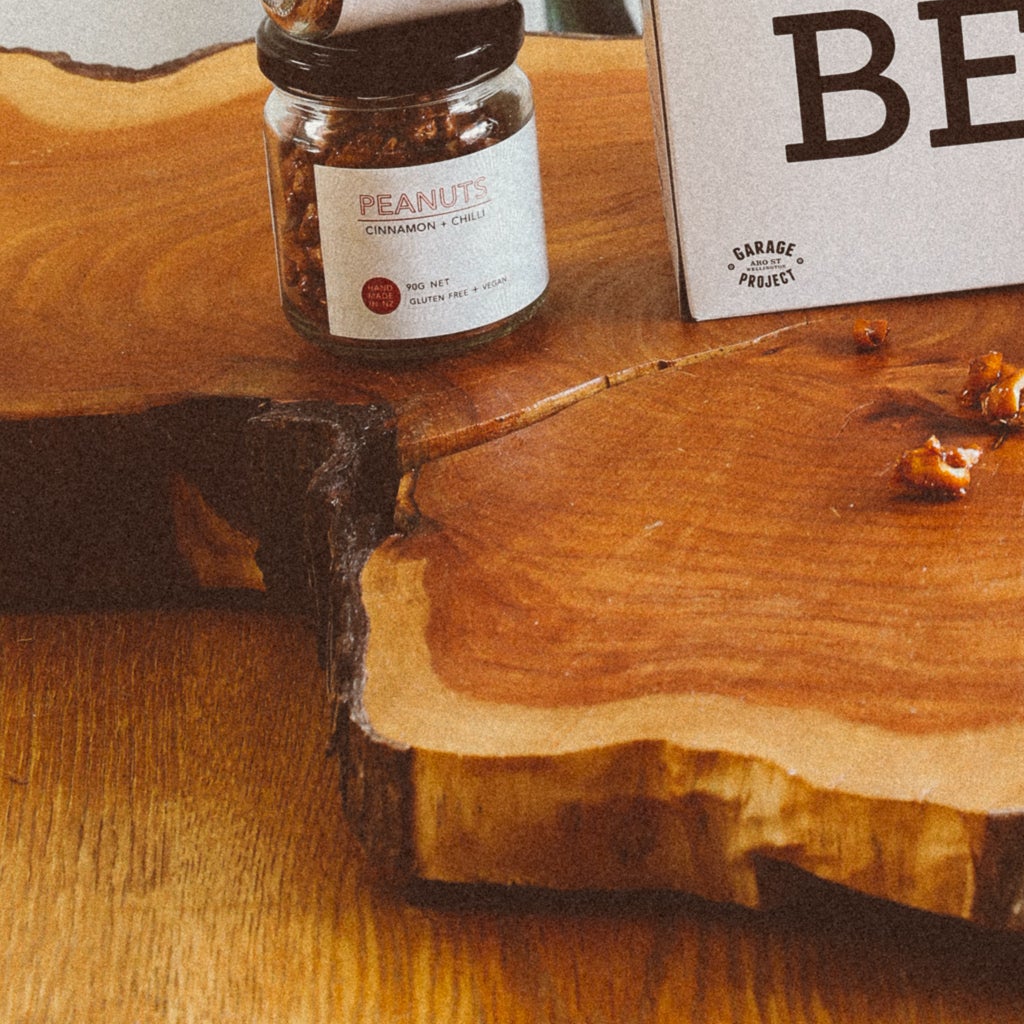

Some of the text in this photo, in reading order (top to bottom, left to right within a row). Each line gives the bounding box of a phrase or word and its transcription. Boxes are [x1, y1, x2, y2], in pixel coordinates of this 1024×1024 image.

[359, 175, 488, 216] PEANUTS
[365, 221, 436, 235] CINNAMON
[451, 209, 486, 226] CHILLI
[732, 240, 796, 261] GARAGE
[406, 278, 450, 292] 90G NET
[738, 268, 796, 288] PROJECT
[409, 294, 445, 305] GLUTEN
[448, 288, 469, 300] FREE
[482, 276, 508, 291] VEGAN
